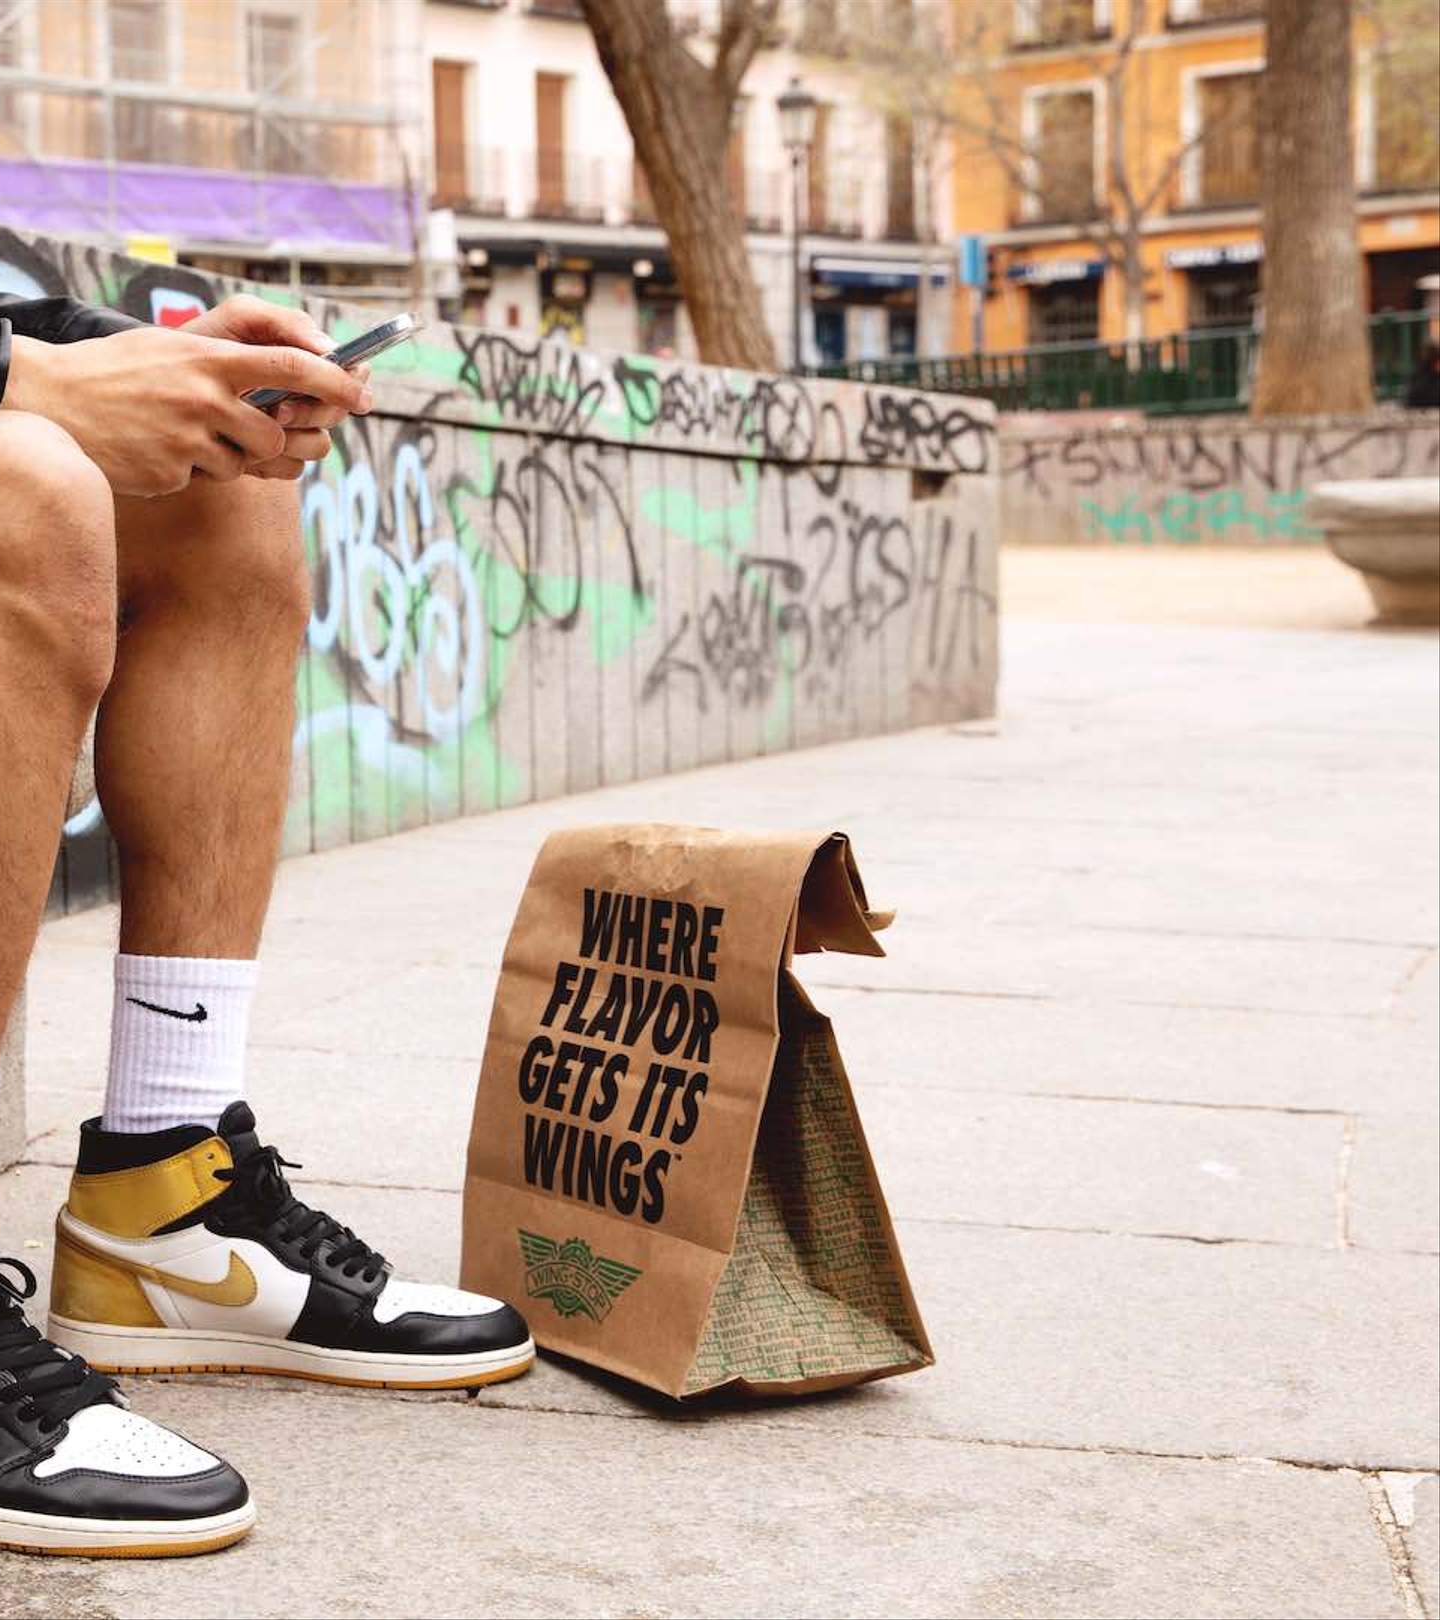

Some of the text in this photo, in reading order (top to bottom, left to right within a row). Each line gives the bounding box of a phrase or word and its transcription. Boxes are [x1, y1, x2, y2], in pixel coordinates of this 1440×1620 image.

[579, 888, 725, 982] WHERE
[539, 961, 720, 1063] FLAVOR
[518, 1035, 709, 1145] GETS ITS
[524, 1114, 671, 1224] WINGS
